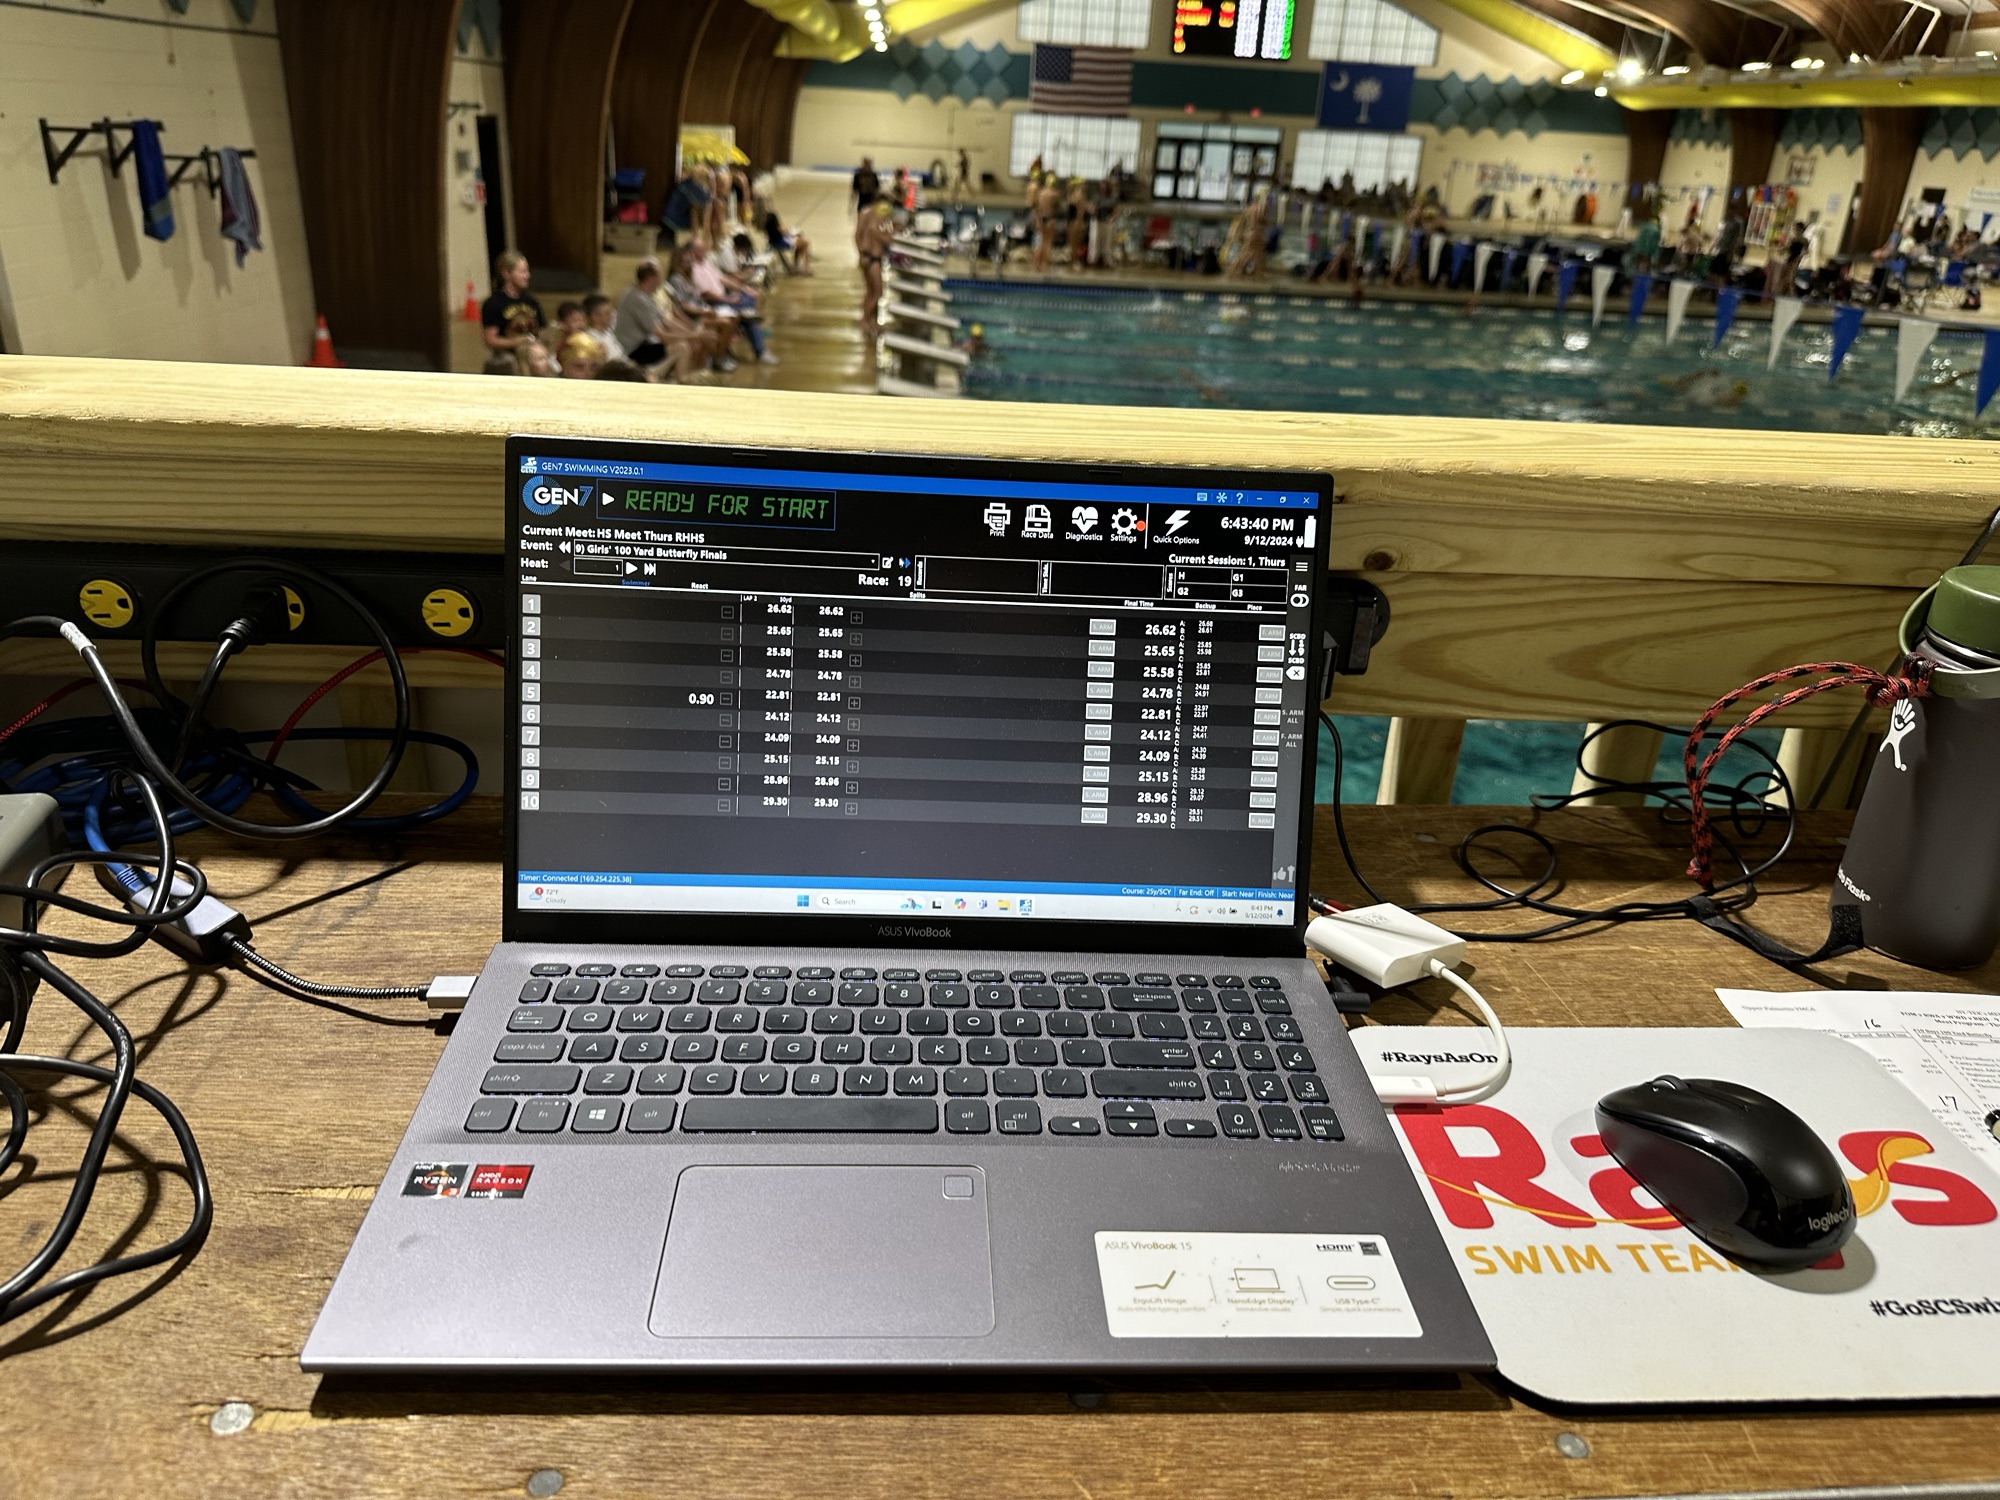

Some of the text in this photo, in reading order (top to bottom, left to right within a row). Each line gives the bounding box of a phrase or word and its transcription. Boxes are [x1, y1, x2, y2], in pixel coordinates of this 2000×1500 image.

[542, 462, 644, 475] GEN7 SWIMMING V2023.0.1
[534, 486, 594, 506] GEN7
[625, 489, 829, 520] READY FOR START
[1221, 517, 1294, 531] 6:43:40 PM
[522, 525, 705, 544] Current Meet: HS Meet Thurs RHHS
[989, 529, 1005, 537] Print
[1021, 530, 1054, 539] Race Data
[1065, 532, 1103, 542] Diagnostics
[1110, 533, 1137, 543] Settings
[1153, 535, 1200, 545] Quick Options
[1244, 535, 1293, 546] 9/12/2024
[521, 540, 553, 551] Event:
[575, 543, 727, 561] 9) Girls' 100 Yard Butterfly Finals
[521, 557, 619, 572] Heat: 1
[1168, 554, 1286, 567] Current Session: 1, Thurs
[858, 574, 912, 587] Race: 19
[1178, 572, 1186, 580] H
[1232, 573, 1244, 582] G1
[691, 582, 709, 590] React
[909, 591, 926, 600] Splits
[1177, 587, 1189, 596] G2
[1232, 589, 1243, 598] G3
[1195, 602, 1217, 611] Backup
[528, 599, 1176, 636] 1 26.62 26.62
[527, 621, 1175, 657] 2 25.65 25.65
[527, 643, 1175, 678] 3 25.58 25.58
[526, 665, 1174, 699] 4 24.78 24.78
[527, 687, 1172, 720] 5 0.90 22.81 22.81
[526, 709, 1171, 741] 6 24.12 24.12
[526, 731, 1170, 762] 7 24.09 24.09
[526, 752, 1169, 783] 8 25.15 25.15
[525, 774, 1168, 804] 9 28.96 28.96
[522, 796, 1167, 824] 10 29.30 29.30
[520, 874, 541, 882] Timer:
[542, 875, 579, 883] Connected
[1122, 887, 1172, 896] Course: 25y/SCY
[1203, 889, 1215, 897] Off
[877, 926, 951, 938] ASUS VivoBook
[1132, 993, 1172, 1001] backspace
[584, 1013, 597, 1022] Q
[633, 1013, 648, 1021] W
[684, 1013, 693, 1022] E
[733, 1014, 742, 1022] R
[782, 1015, 789, 1023] T
[830, 1015, 838, 1023] Y
[875, 1016, 885, 1024] U
[926, 1017, 929, 1025] I
[968, 1017, 980, 1025] O
[1017, 1018, 1024, 1026] P
[526, 1042, 545, 1050] lock
[1380, 1051, 1512, 1065] #RaysAsOn
[489, 1074, 511, 1082] shift
[1168, 1080, 1187, 1088] shift
[474, 1109, 492, 1118] ctrl
[644, 1110, 658, 1119] alt
[413, 1176, 458, 1185] RYZEN
[1808, 1205, 1850, 1232] logitech
[1105, 1241, 1192, 1251] ASUS VivoBook 15
[1316, 1243, 1353, 1252] HDMI
[1465, 1243, 1741, 1277] SWIM TEA
[1869, 1297, 2000, 1317] #GoSCSwi
